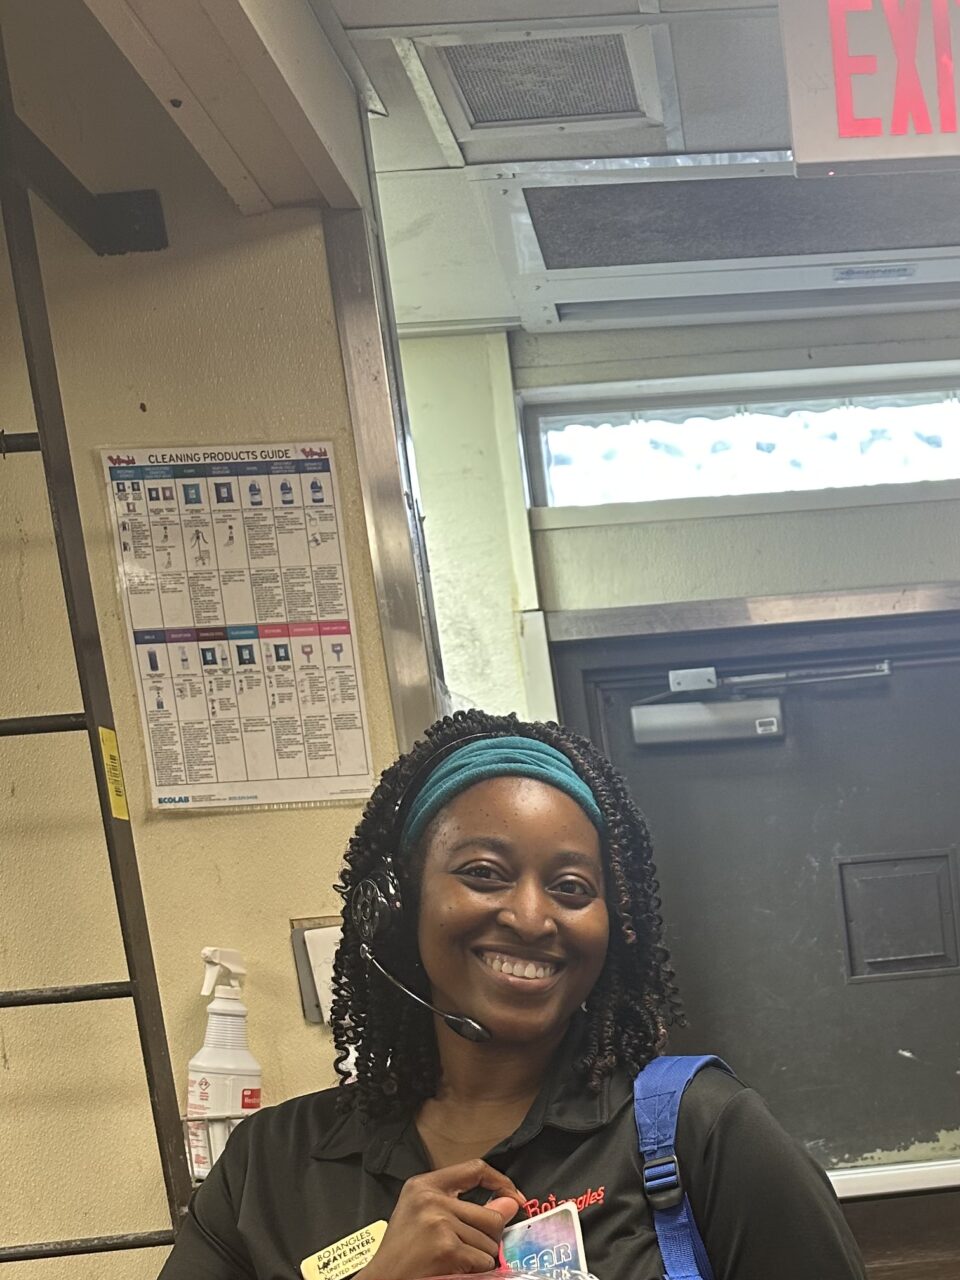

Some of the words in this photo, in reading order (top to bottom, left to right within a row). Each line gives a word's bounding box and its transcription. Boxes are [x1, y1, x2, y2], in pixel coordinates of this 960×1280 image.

[148, 453, 201, 464] CLEANING
[203, 450, 258, 462] PRODUCTS
[260, 449, 291, 460] GUIDE
[158, 796, 190, 805] ECOLAB
[317, 1229, 372, 1262] BOJANGLES
[348, 1236, 376, 1254] MYERS
